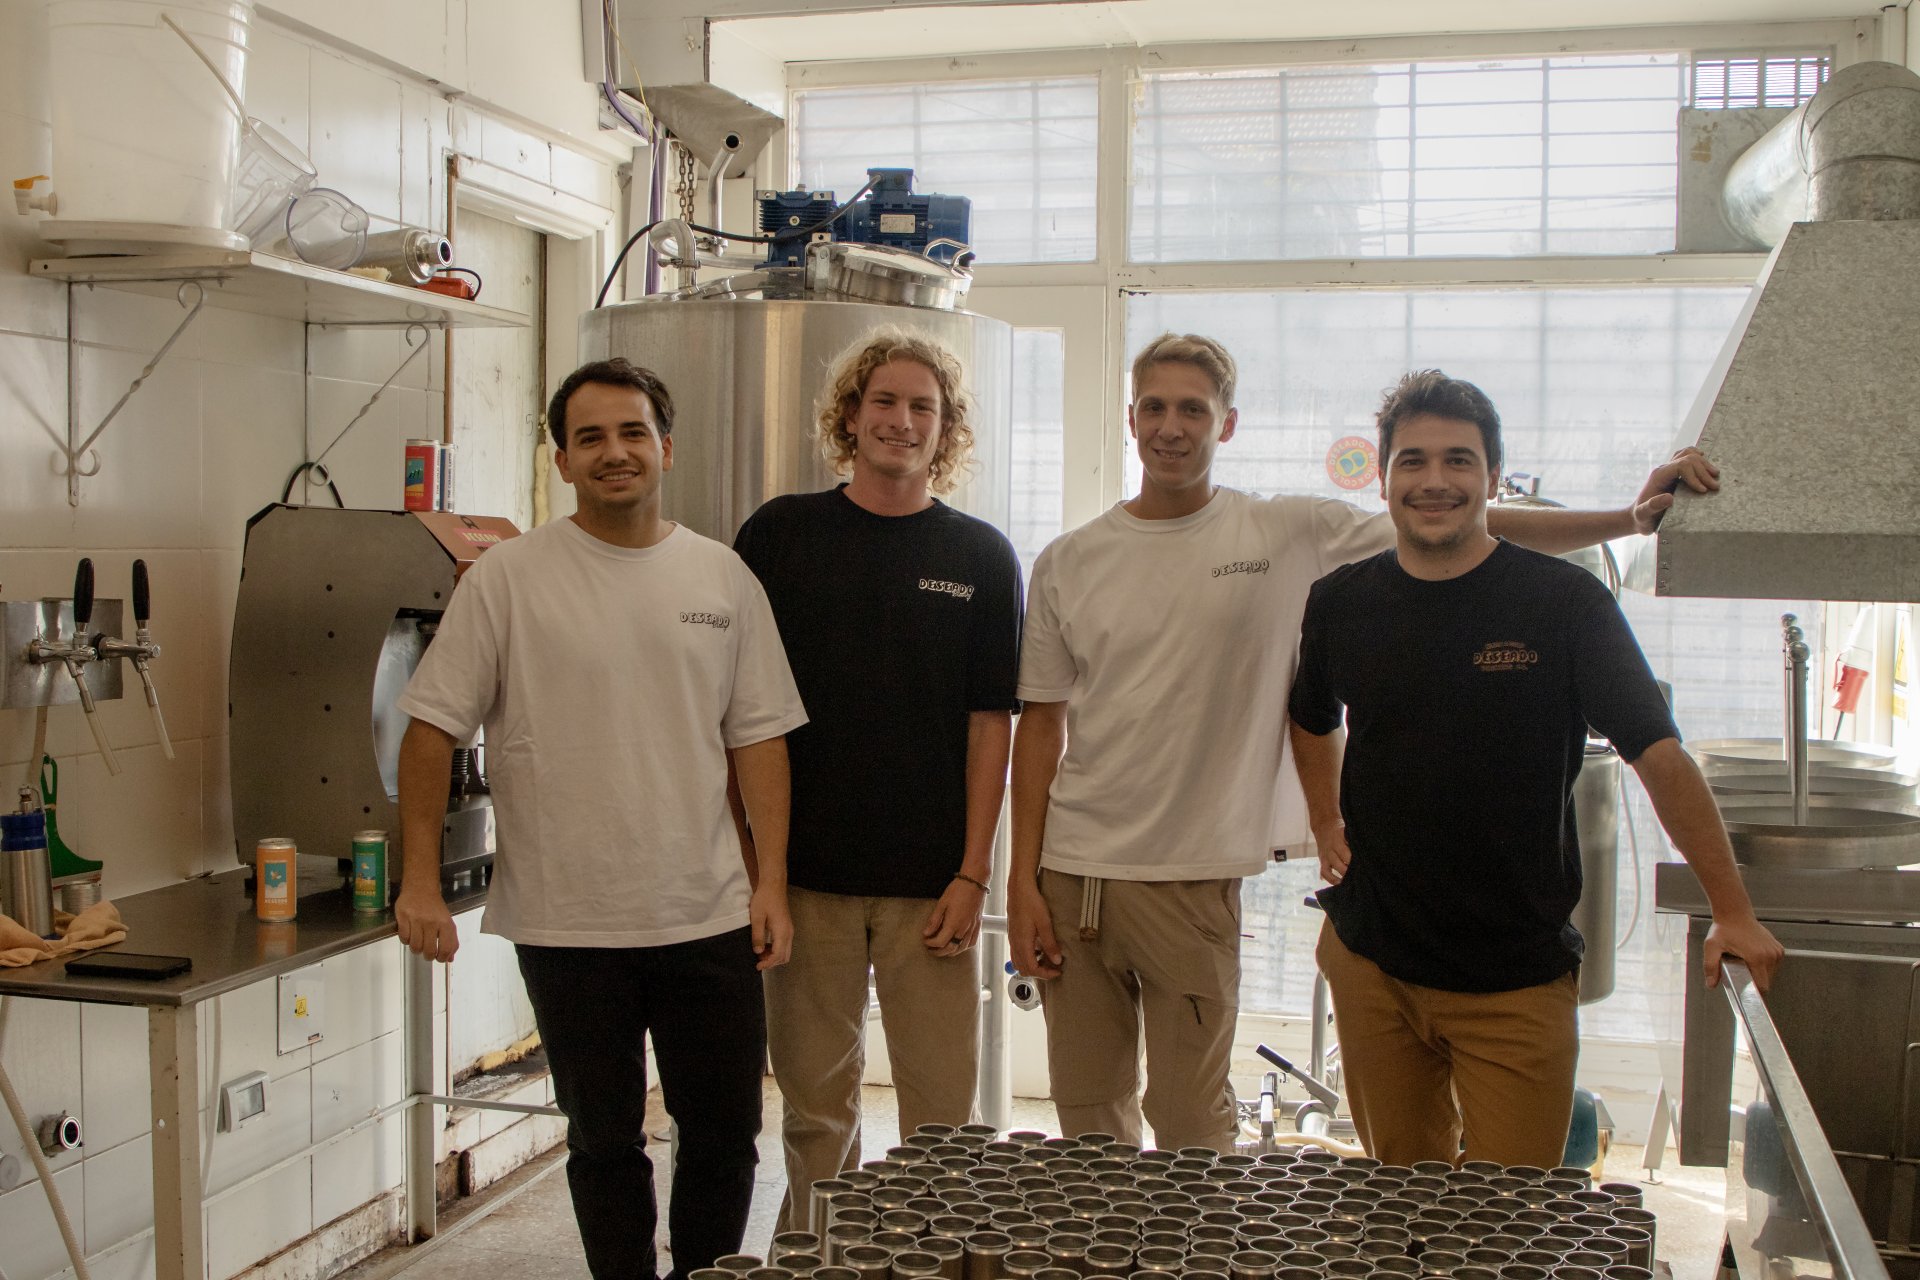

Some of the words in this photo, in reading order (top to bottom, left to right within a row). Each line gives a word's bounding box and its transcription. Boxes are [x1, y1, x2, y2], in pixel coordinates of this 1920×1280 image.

[1211, 558, 1270, 578] DESEADO
[919, 578, 975, 597] DESEADO
[679, 611, 730, 629] DESEADO
[1473, 649, 1538, 665] DESEADO
